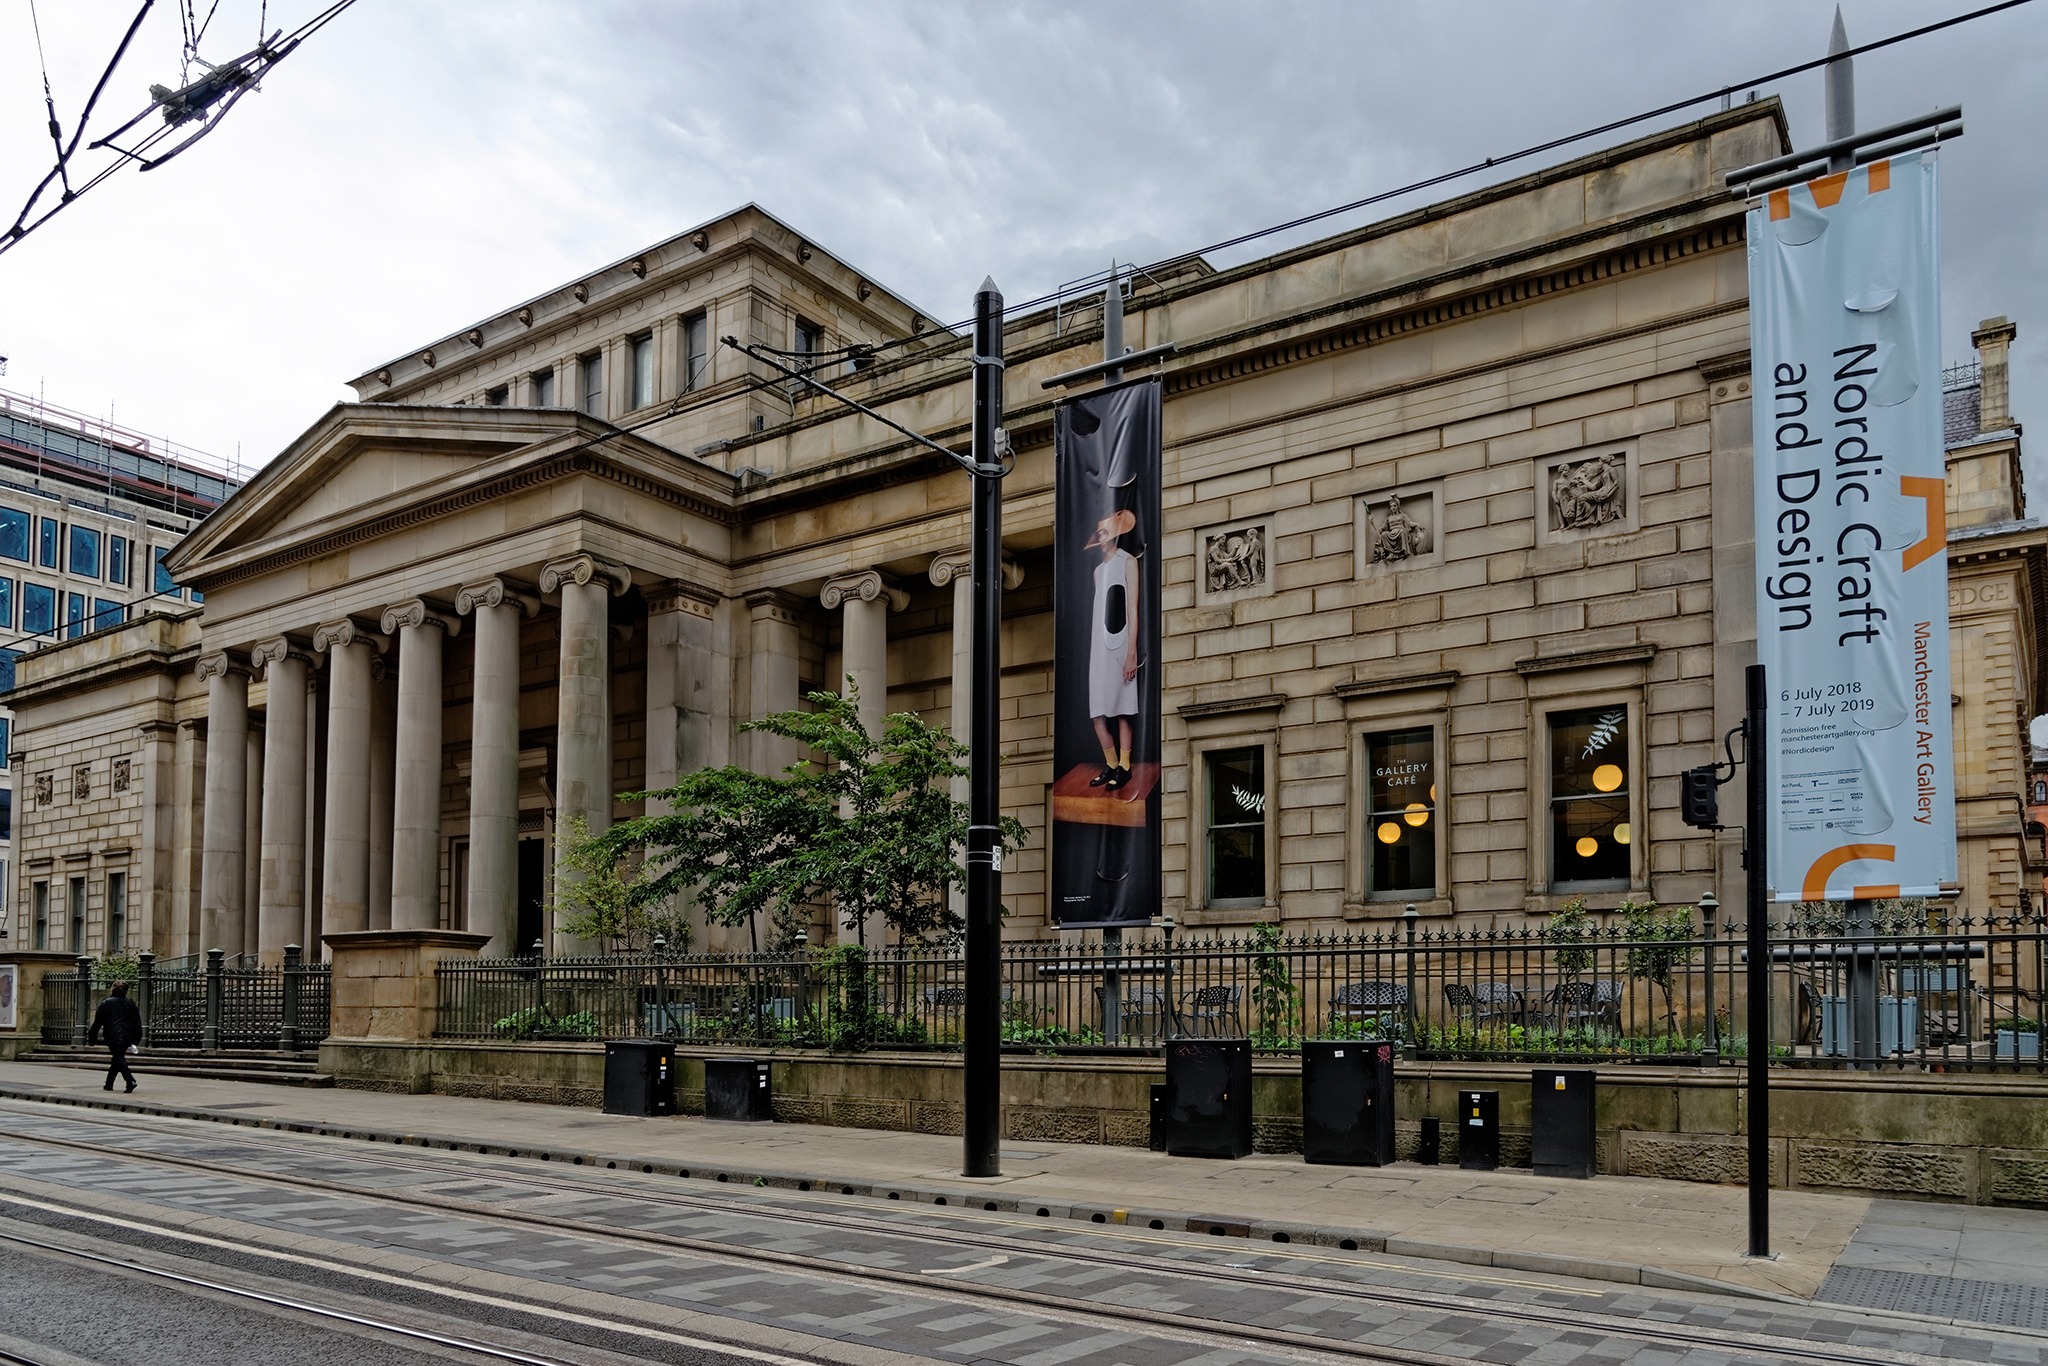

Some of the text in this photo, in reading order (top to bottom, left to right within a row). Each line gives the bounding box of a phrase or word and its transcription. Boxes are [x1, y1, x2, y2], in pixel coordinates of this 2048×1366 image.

[1765, 362, 1824, 632] and Design
[1834, 343, 1887, 648] Nordic Craft
[1948, 583, 2009, 607] EDGE
[1781, 681, 1862, 702] 6 July 2018
[1794, 705, 1802, 717] 7
[1807, 702, 1836, 717] July
[1841, 698, 1875, 713] 2019
[1781, 723, 1837, 735] Admission free
[1913, 621, 1936, 825] Manchester Art Gallery
[1781, 729, 1876, 743] manchesterartgallery.org
[1781, 745, 1835, 756] #Nordicdesign
[1376, 763, 1428, 776] GALLERY
[1388, 774, 1416, 787] CAFÉ
